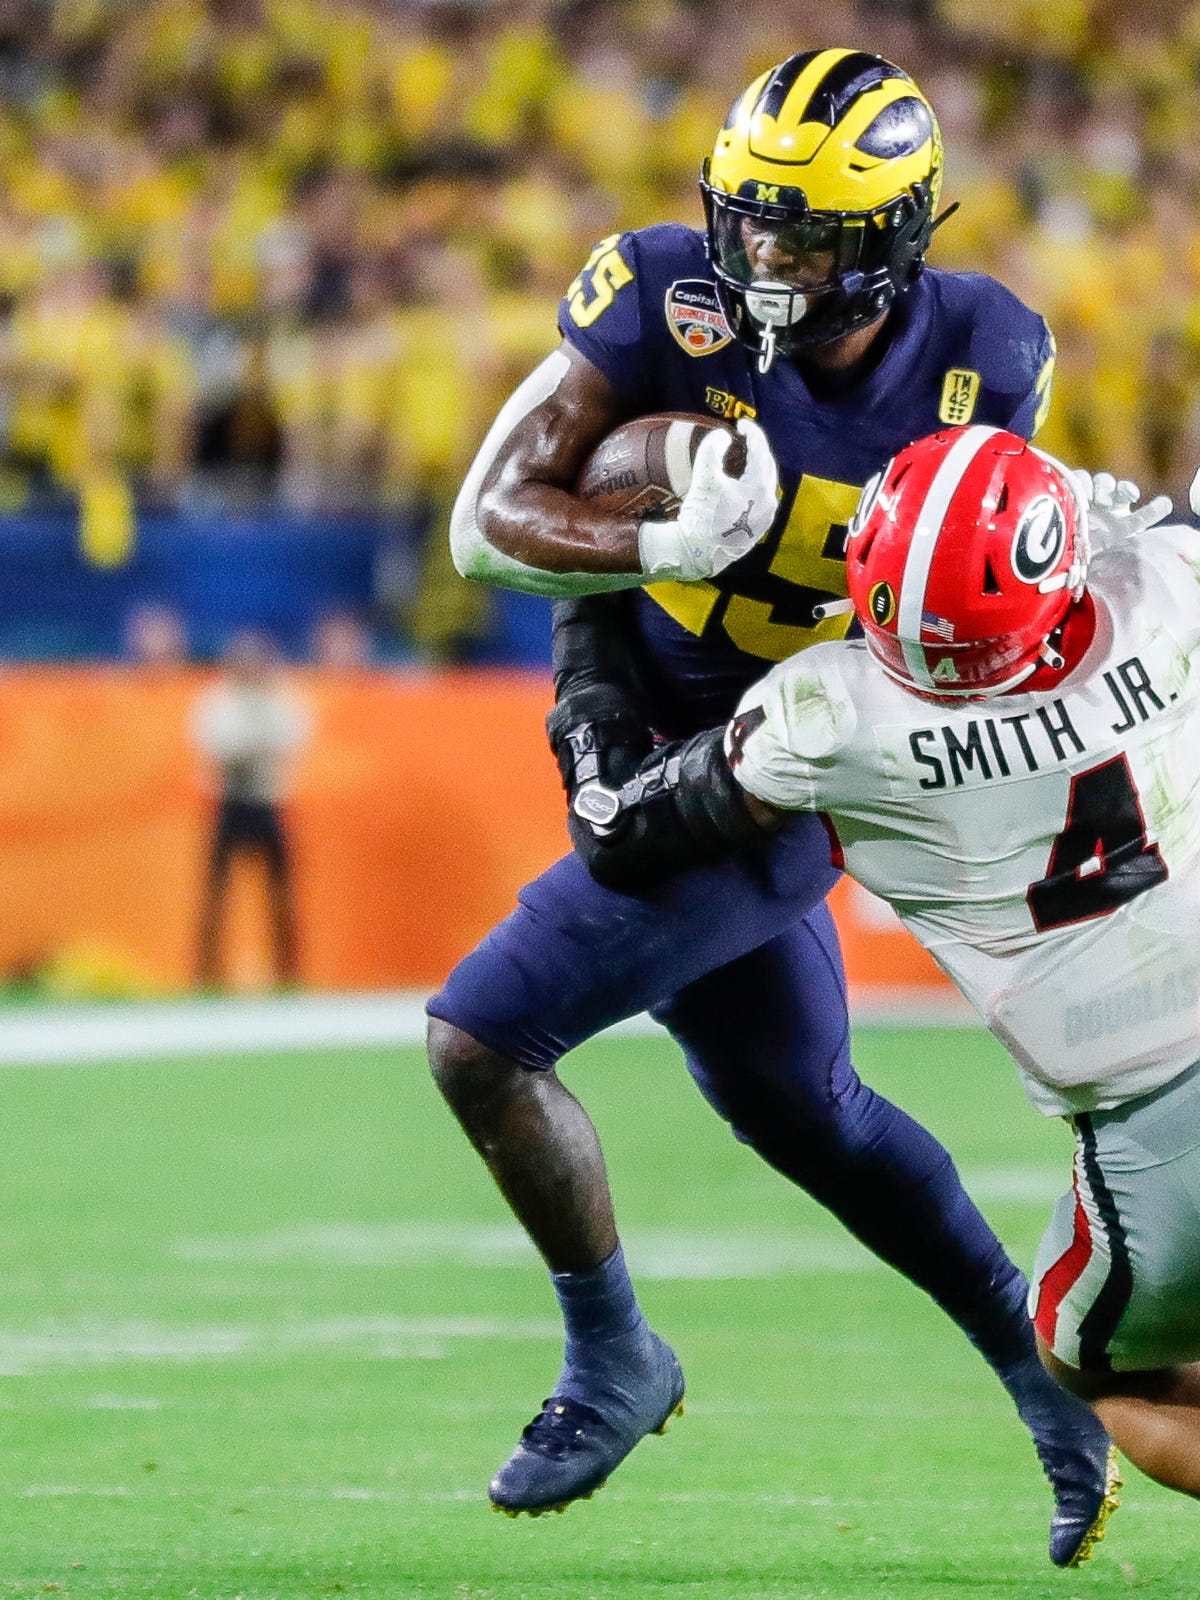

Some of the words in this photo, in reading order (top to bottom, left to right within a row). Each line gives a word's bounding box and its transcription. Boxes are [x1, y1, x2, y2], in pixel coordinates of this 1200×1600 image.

[756, 183, 780, 203] M
[675, 290, 716, 308] Capital
[707, 312, 728, 331] BOW
[950, 391, 969, 408] 42
[1010, 495, 1066, 584] G
[933, 657, 961, 682] 4
[908, 698, 1087, 791] SMITH
[1102, 656, 1178, 735] JR.
[1026, 752, 1170, 933] 4
